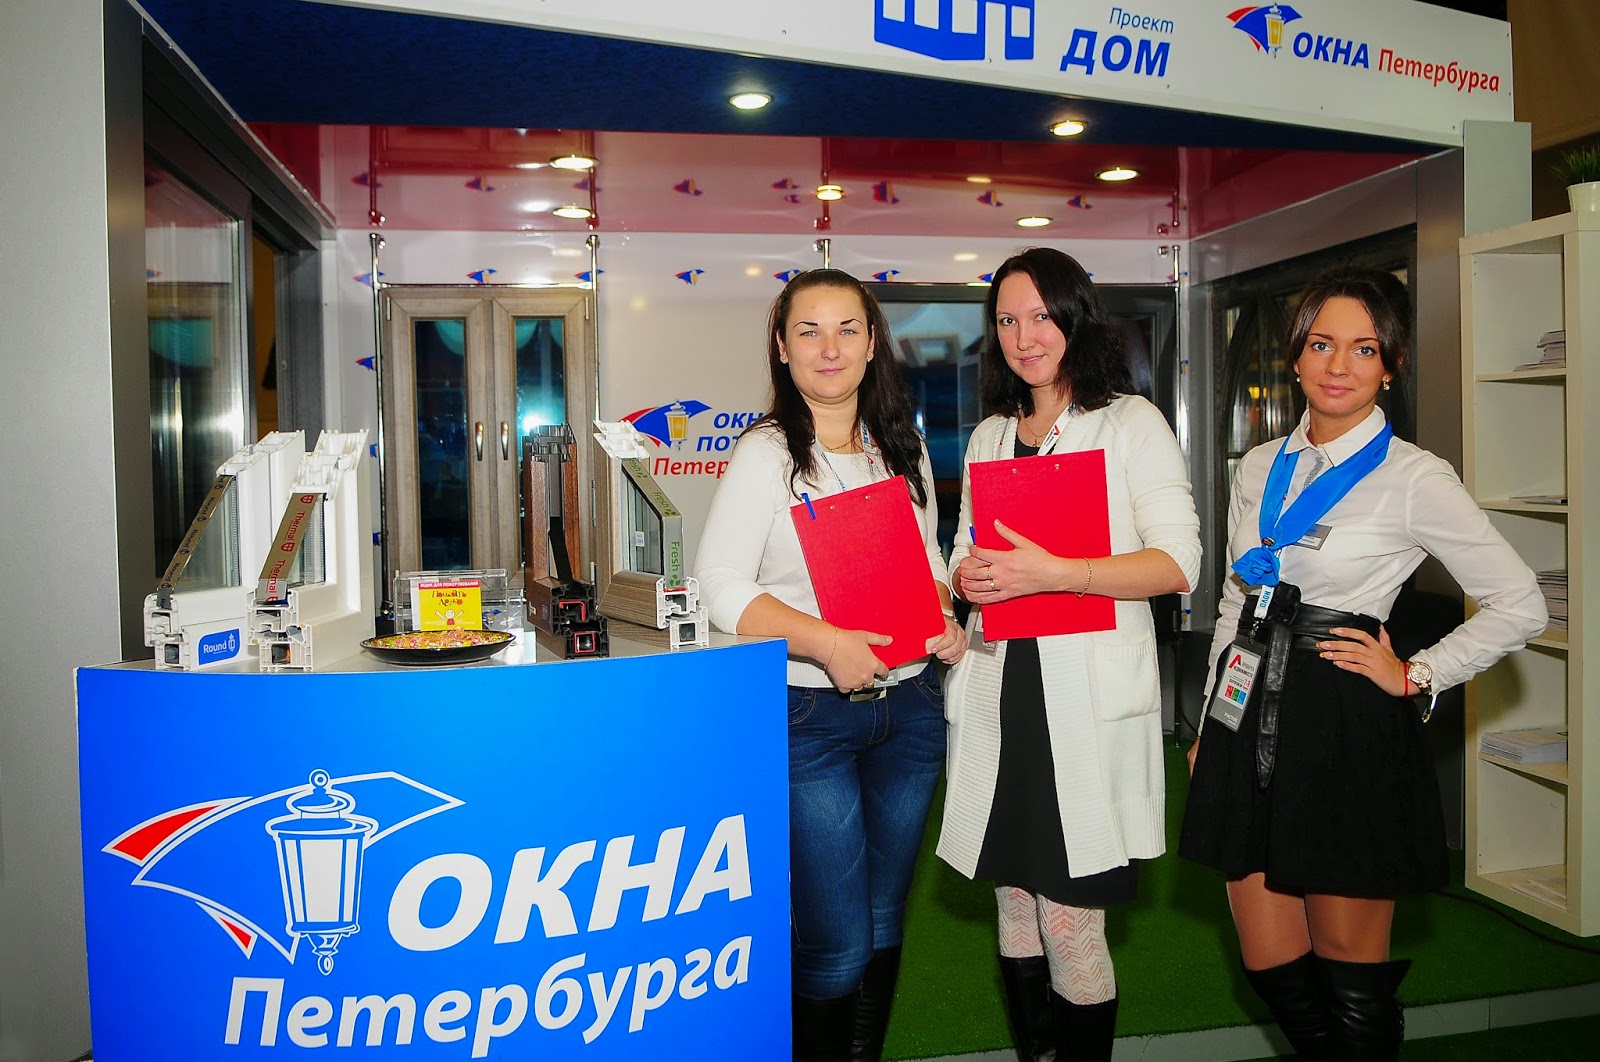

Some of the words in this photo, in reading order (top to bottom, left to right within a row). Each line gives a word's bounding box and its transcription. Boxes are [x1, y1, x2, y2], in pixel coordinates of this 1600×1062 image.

[1109, 7, 1175, 34] Проект
[1060, 28, 1171, 77] ДОМ
[1292, 31, 1369, 69] ОКНА
[1378, 48, 1500, 93] Петербурга
[713, 412, 764, 429] ОКН
[653, 457, 730, 479] Петер
[285, 511, 305, 541] Thermal
[671, 541, 681, 571] Fresh
[266, 559, 286, 593] Thermal
[203, 641, 228, 654] Round
[387, 814, 753, 952] ОКНА
[225, 935, 753, 1059] Петербурга
